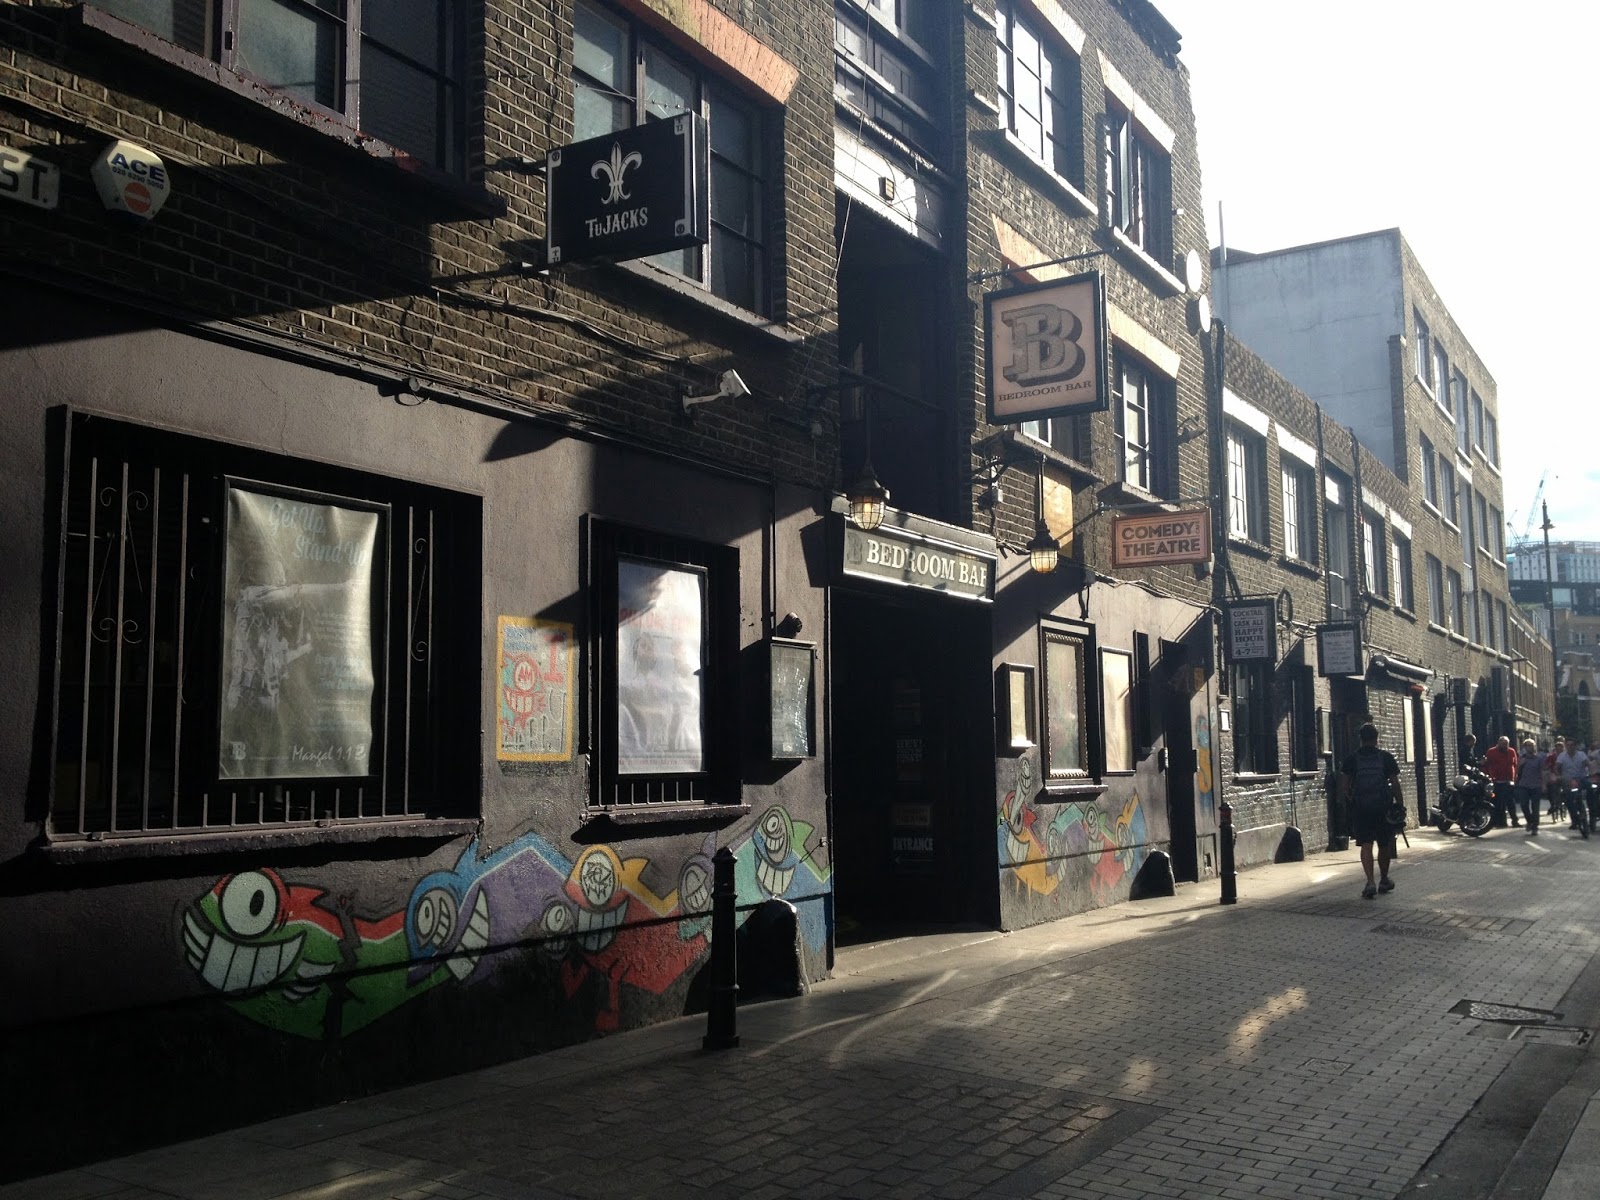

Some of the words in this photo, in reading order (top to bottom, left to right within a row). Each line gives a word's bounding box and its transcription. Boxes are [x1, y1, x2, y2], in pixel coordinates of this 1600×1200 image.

[111, 152, 165, 183] ACE
[998, 385, 1062, 402] BEDROOM
[1065, 380, 1092, 392] BAR
[269, 501, 297, 536] Get
[1121, 521, 1195, 541] COMEDY
[292, 533, 343, 564] Stand
[1122, 538, 1201, 557] THEATRE
[866, 539, 956, 581] BEDROOM
[1233, 609, 1264, 617] COCKTAIL
[1234, 627, 1264, 636] HAPPY
[1235, 635, 1264, 643] HOUR
[1235, 648, 1251, 656] 4-7
[291, 744, 333, 767] Mangal
